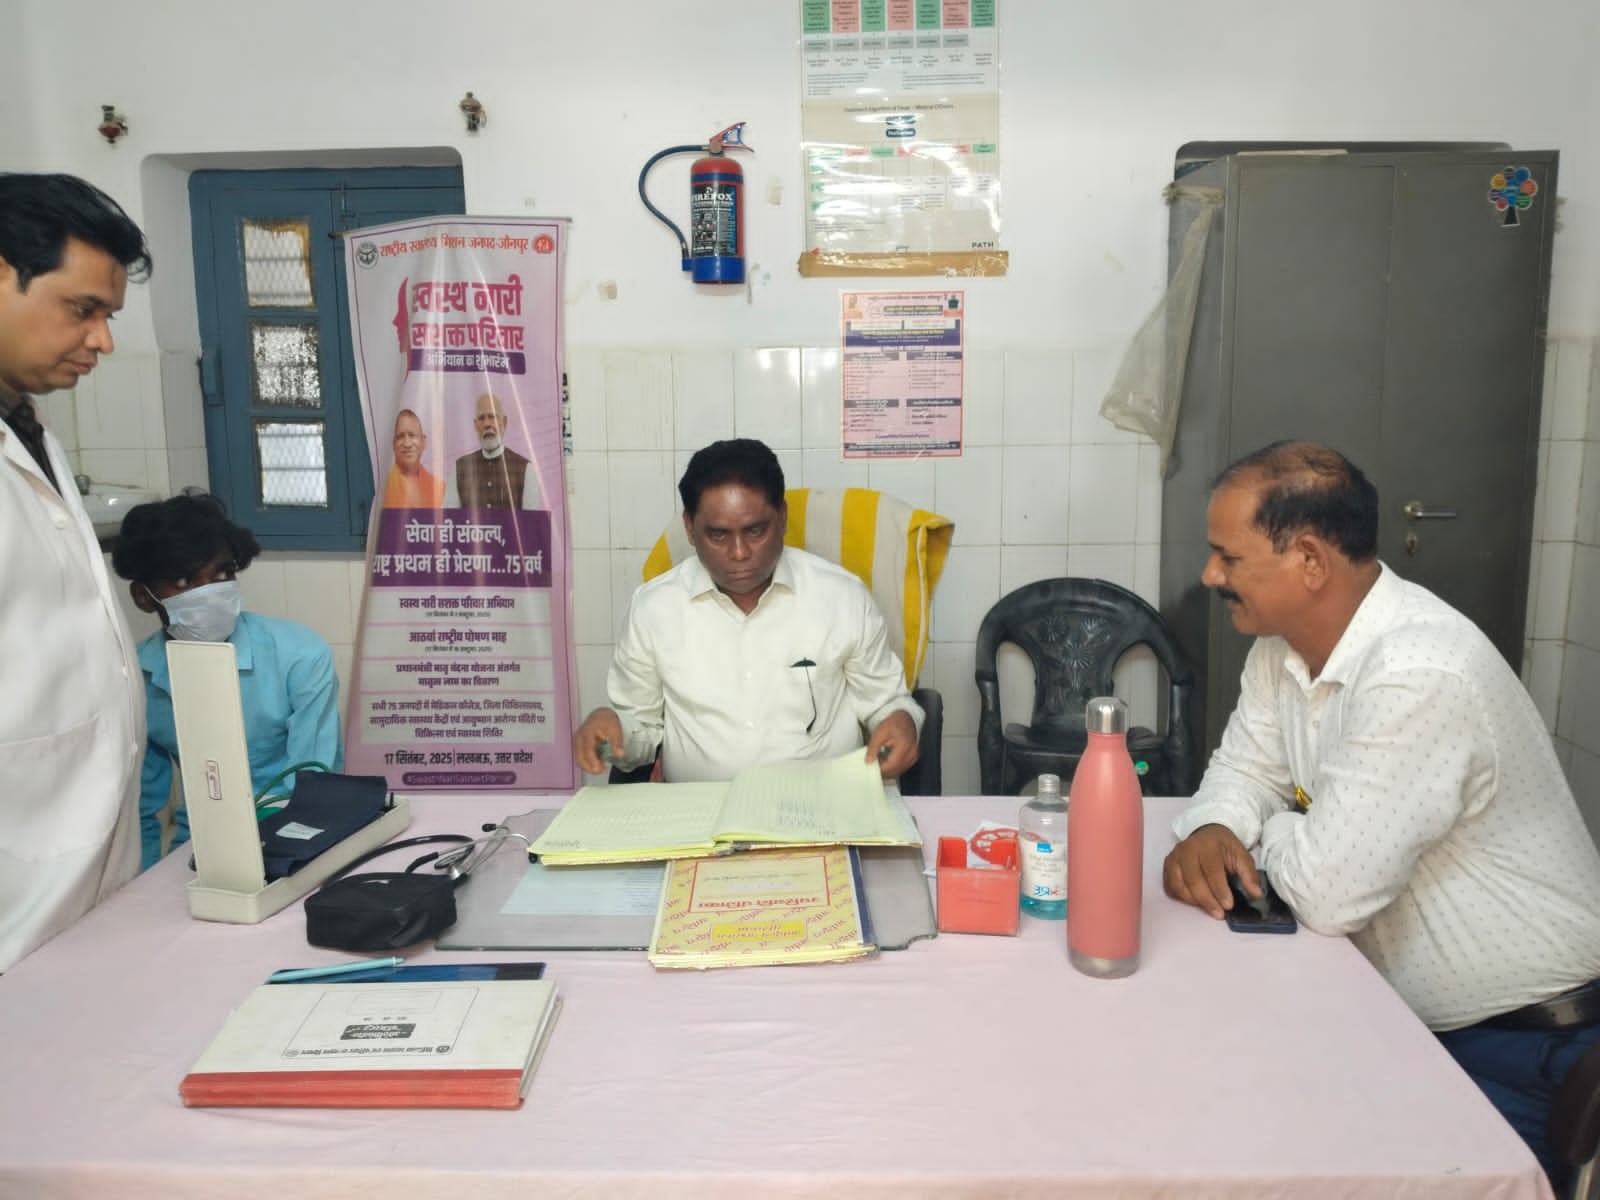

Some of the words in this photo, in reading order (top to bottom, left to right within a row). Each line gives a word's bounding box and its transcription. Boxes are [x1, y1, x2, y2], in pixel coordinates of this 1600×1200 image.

[380, 240, 407, 257] राष्ट्रीय
[412, 281, 468, 313] स्वस्थ
[471, 273, 523, 316] नारी
[467, 316, 525, 350] परिवार
[405, 519, 434, 543] सेवा
[437, 519, 453, 543] ही
[455, 520, 506, 546] संकल्प,
[393, 554, 432, 574] प्रथम
[434, 548, 451, 573] ही
[522, 550, 543, 574] वर्ष
[421, 595, 436, 608] नारी
[461, 595, 485, 608] परिवार
[487, 595, 515, 608] अभियान
[438, 628, 463, 644] राष्ट्रीय
[464, 629, 490, 642] पोषण
[491, 632, 507, 643] माह
[384, 753, 394, 765] 17
[429, 752, 452, 764] 2025
